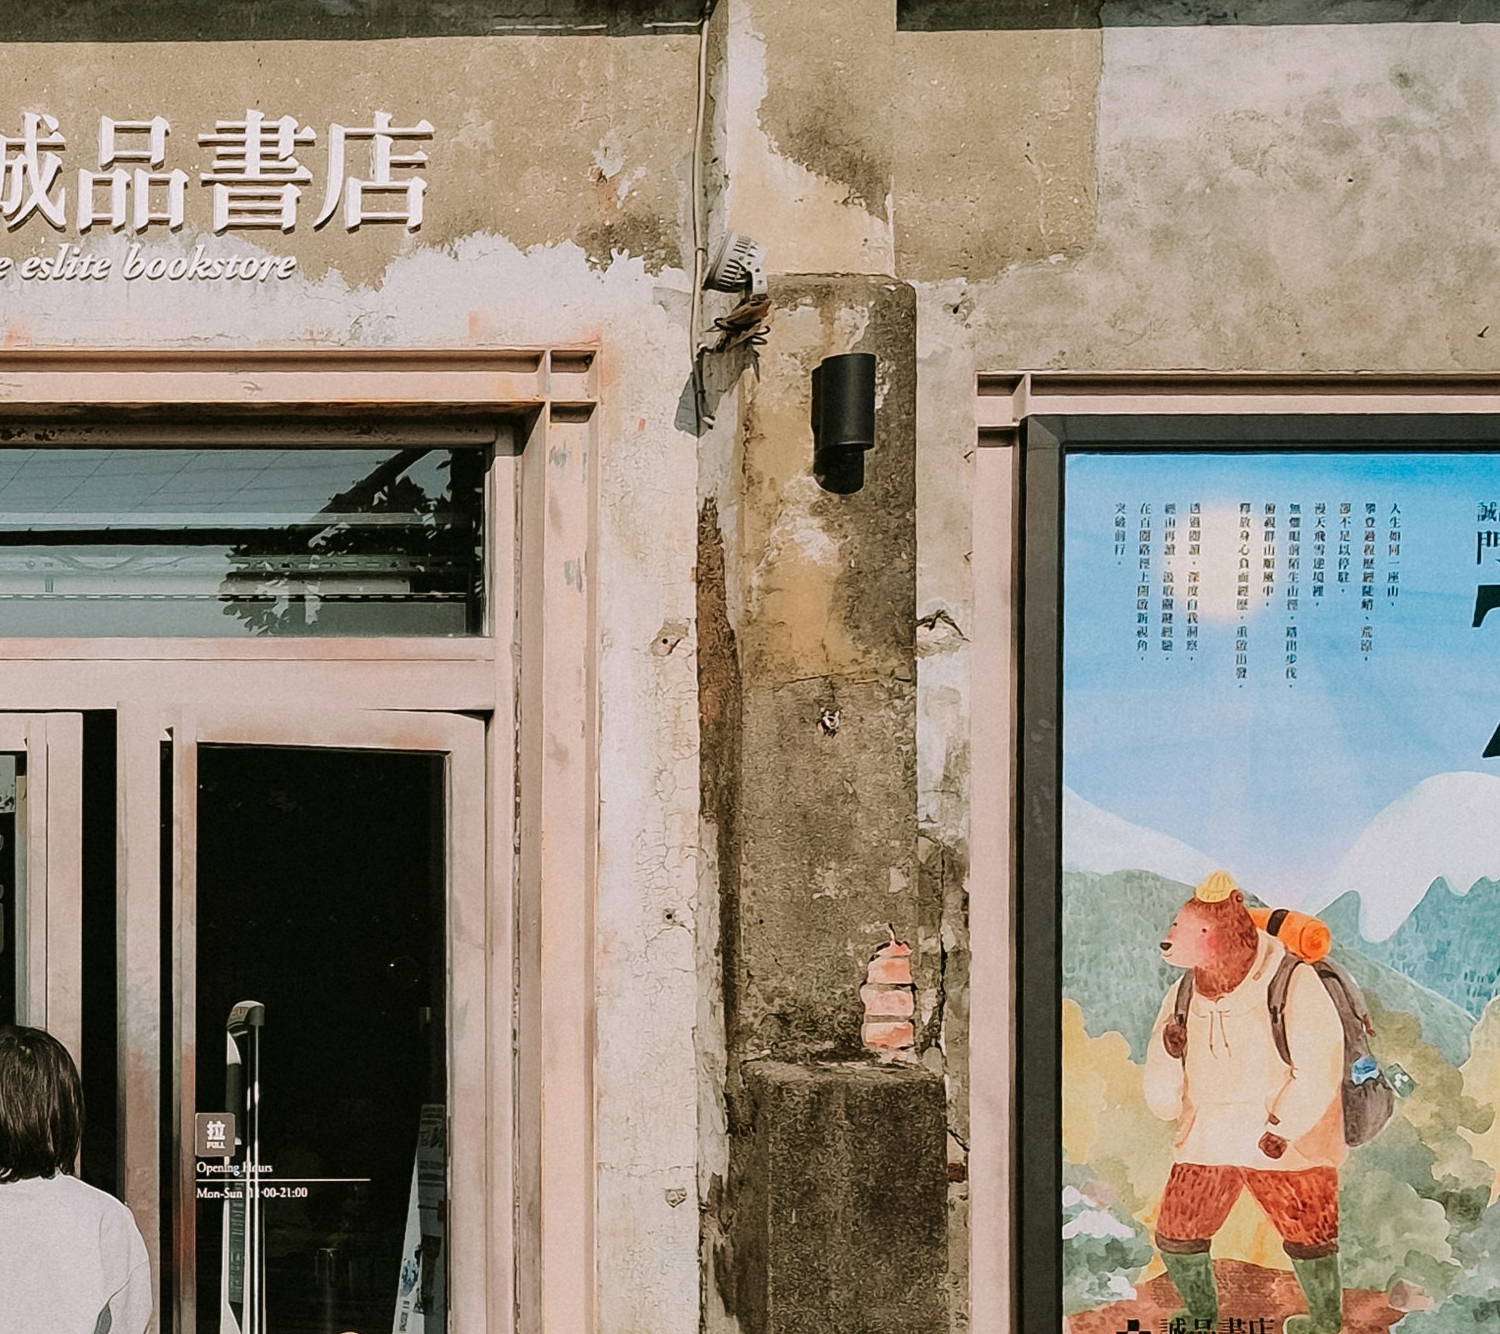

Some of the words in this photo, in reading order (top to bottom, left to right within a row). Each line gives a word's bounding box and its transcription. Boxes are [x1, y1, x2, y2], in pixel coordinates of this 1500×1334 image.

[20, 244, 111, 282] eslite
[122, 244, 297, 283] bookstore
[1476, 501, 1500, 522] 誠
[206, 1120, 226, 1140] 拉
[196, 1161, 240, 1177] Opening
[196, 1187, 243, 1199] Mon-Sun
